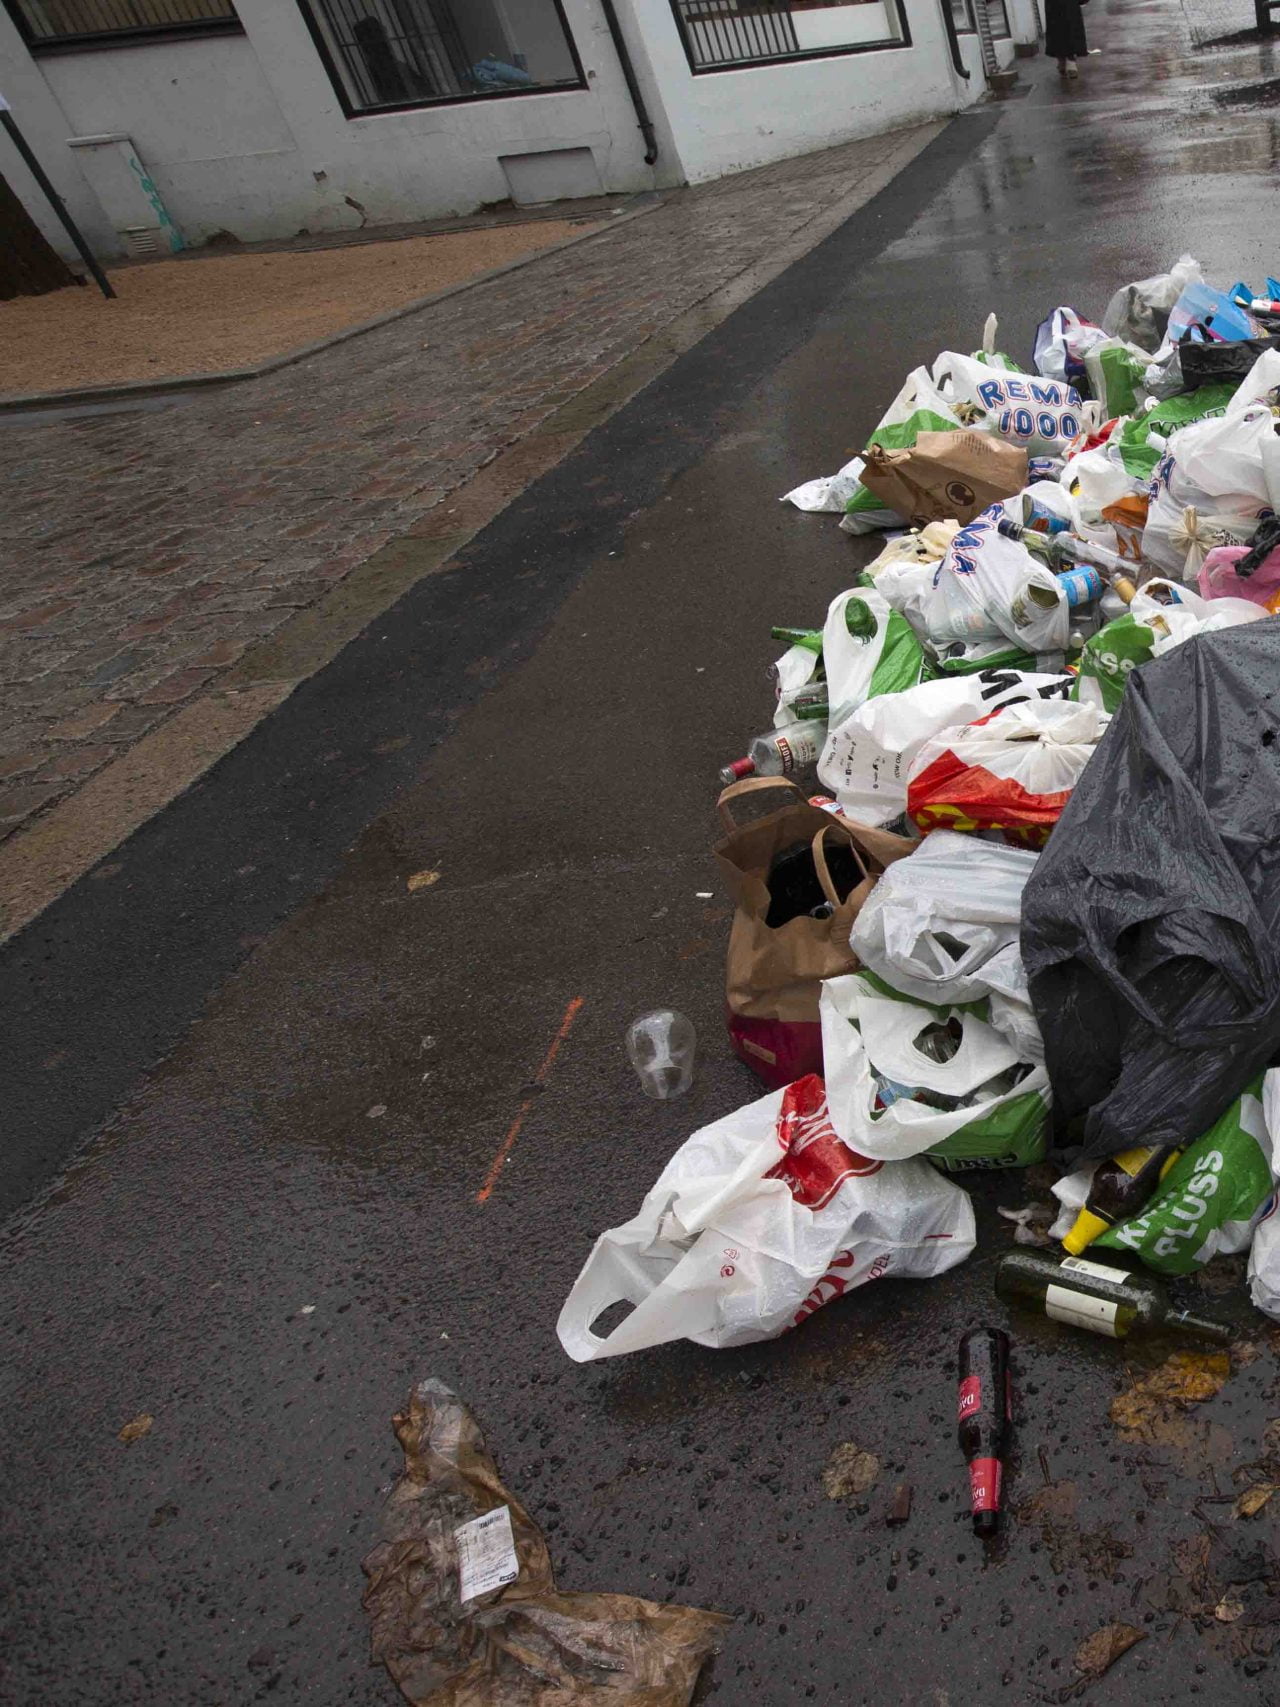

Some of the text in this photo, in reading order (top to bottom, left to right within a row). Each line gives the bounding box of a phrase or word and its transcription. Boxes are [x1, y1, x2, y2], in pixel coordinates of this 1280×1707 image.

[977, 379, 1083, 410] REMA
[998, 407, 1080, 440] 1000
[1153, 1150, 1224, 1257] PLUSS
